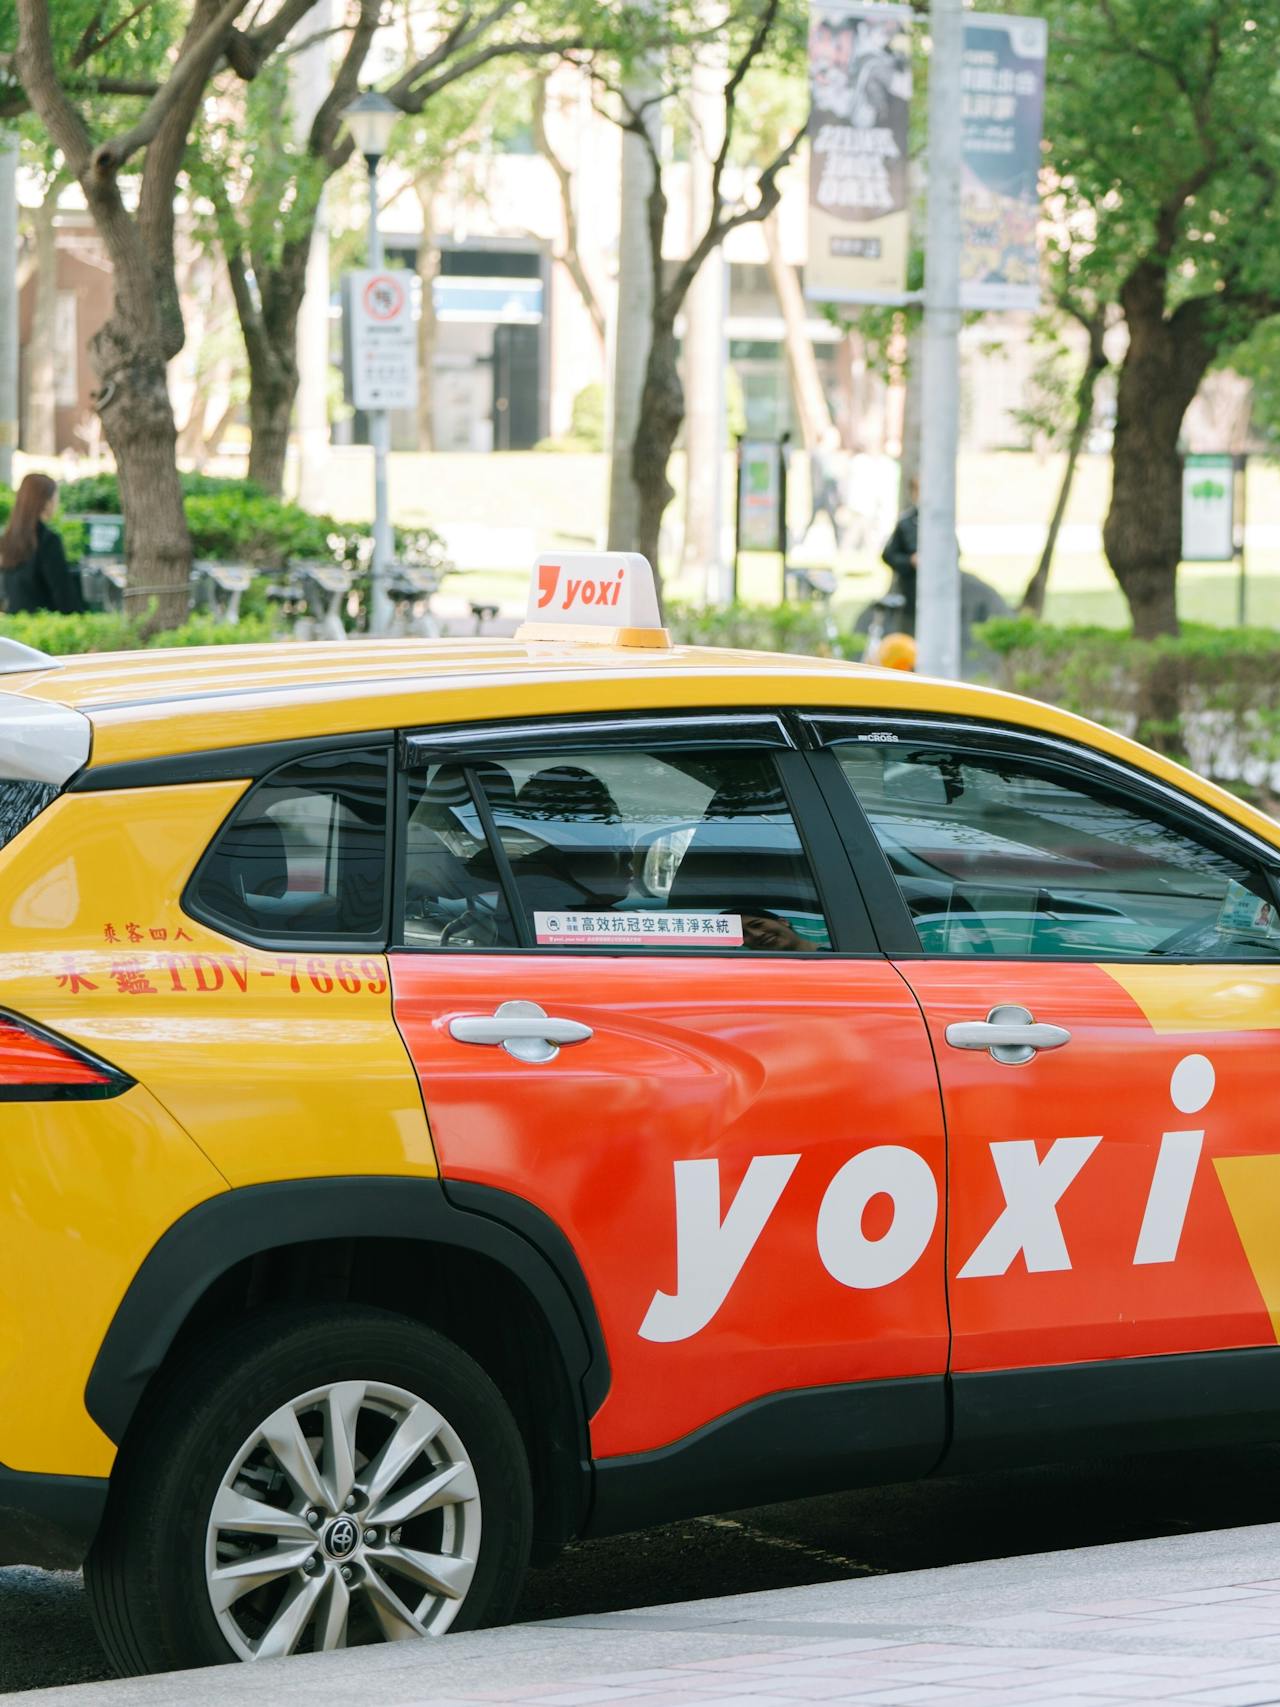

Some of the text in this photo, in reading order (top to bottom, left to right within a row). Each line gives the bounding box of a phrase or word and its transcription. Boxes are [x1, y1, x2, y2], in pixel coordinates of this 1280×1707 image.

[562, 568, 624, 609] yoxi
[867, 734, 899, 742] CROSS
[581, 916, 730, 934] 高效抗冠空氣清淨系統
[158, 953, 388, 995] TDV-7669
[637, 1054, 1216, 1343] yoxi
